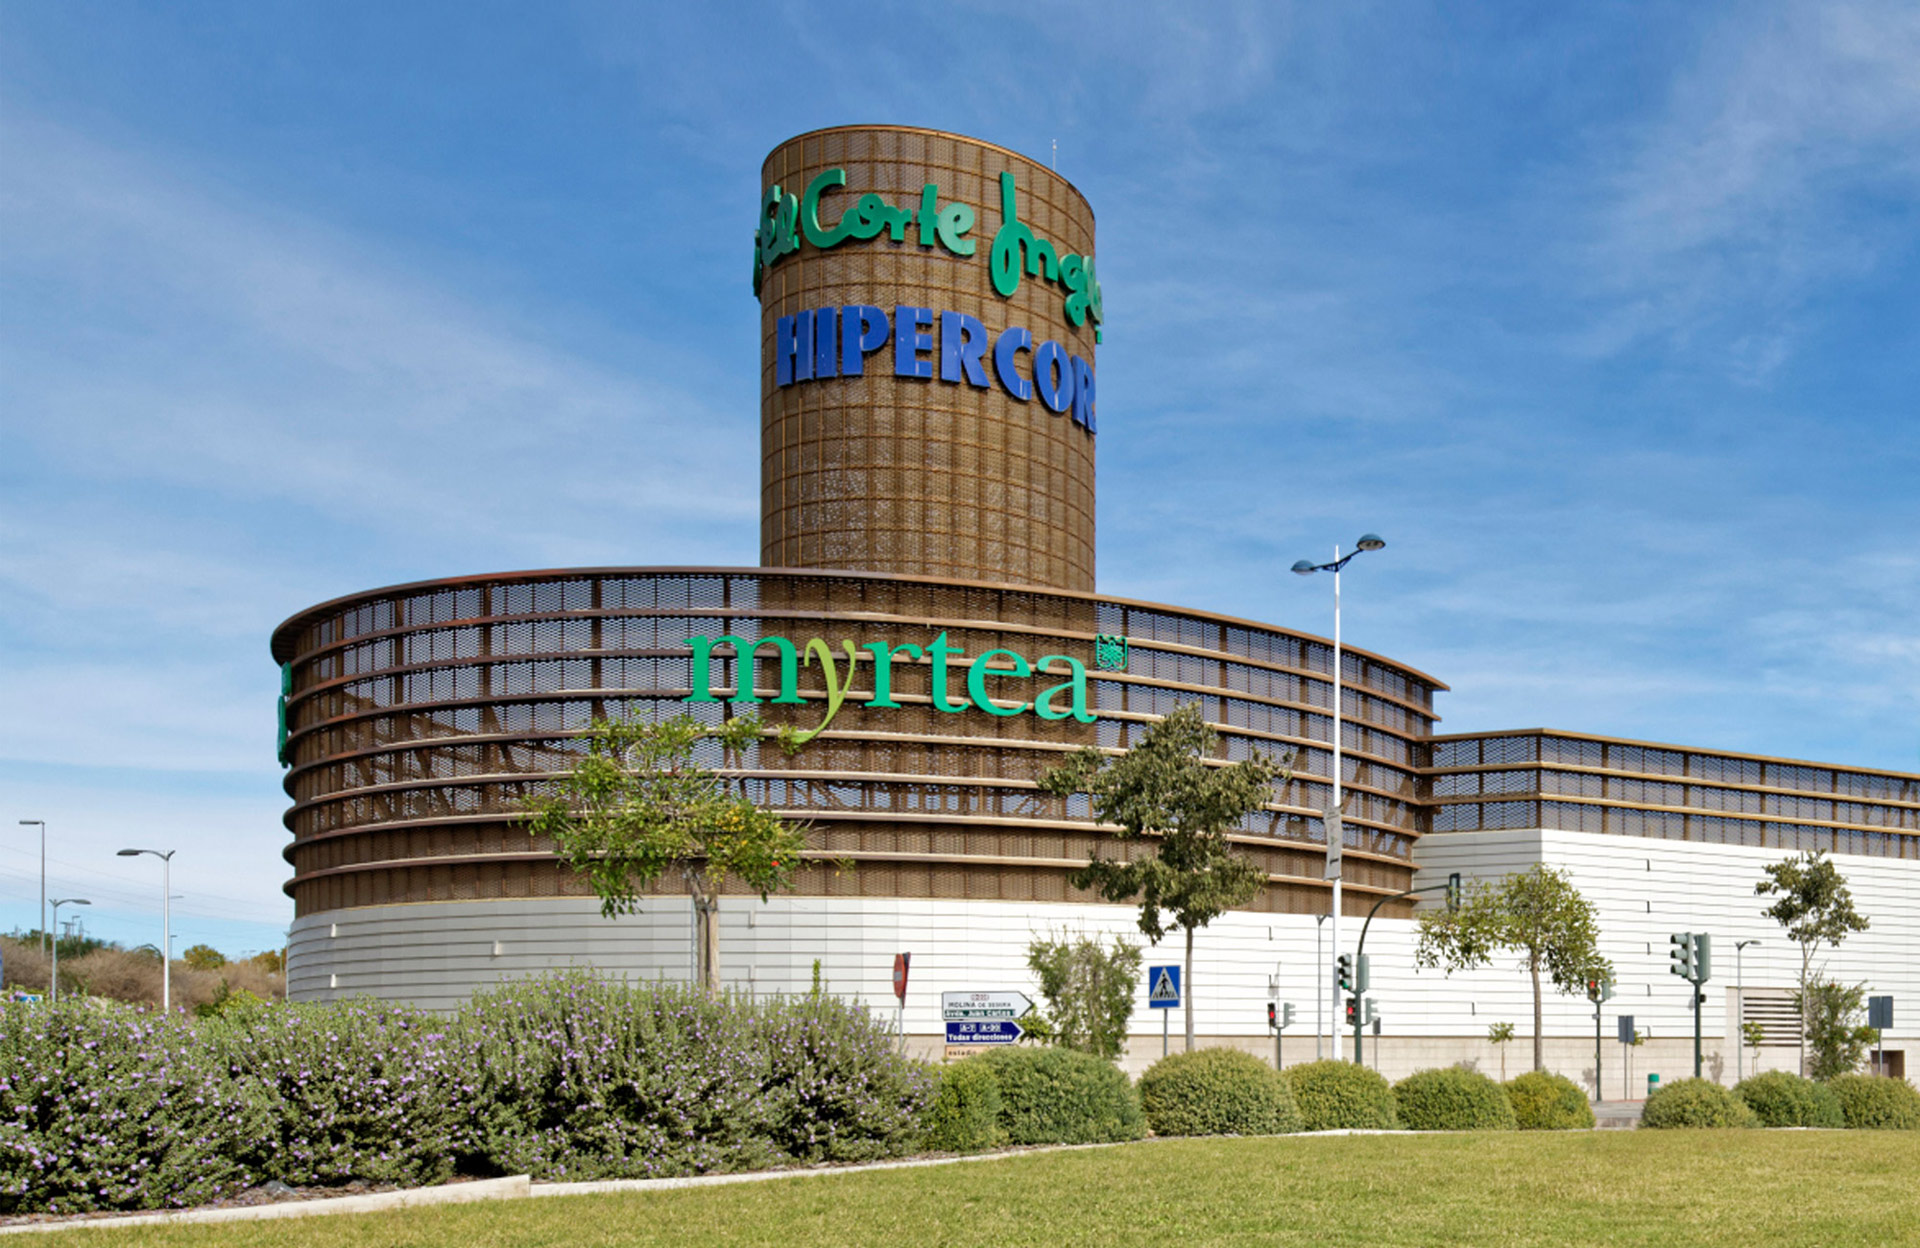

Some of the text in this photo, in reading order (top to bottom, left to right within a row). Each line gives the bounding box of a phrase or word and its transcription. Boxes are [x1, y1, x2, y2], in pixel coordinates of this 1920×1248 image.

[761, 184, 800, 267] El
[801, 168, 977, 256] Corte
[776, 304, 1098, 434] HIPERCOR
[682, 630, 1098, 744] myrtea
[972, 1033, 1013, 1041] direcciones
